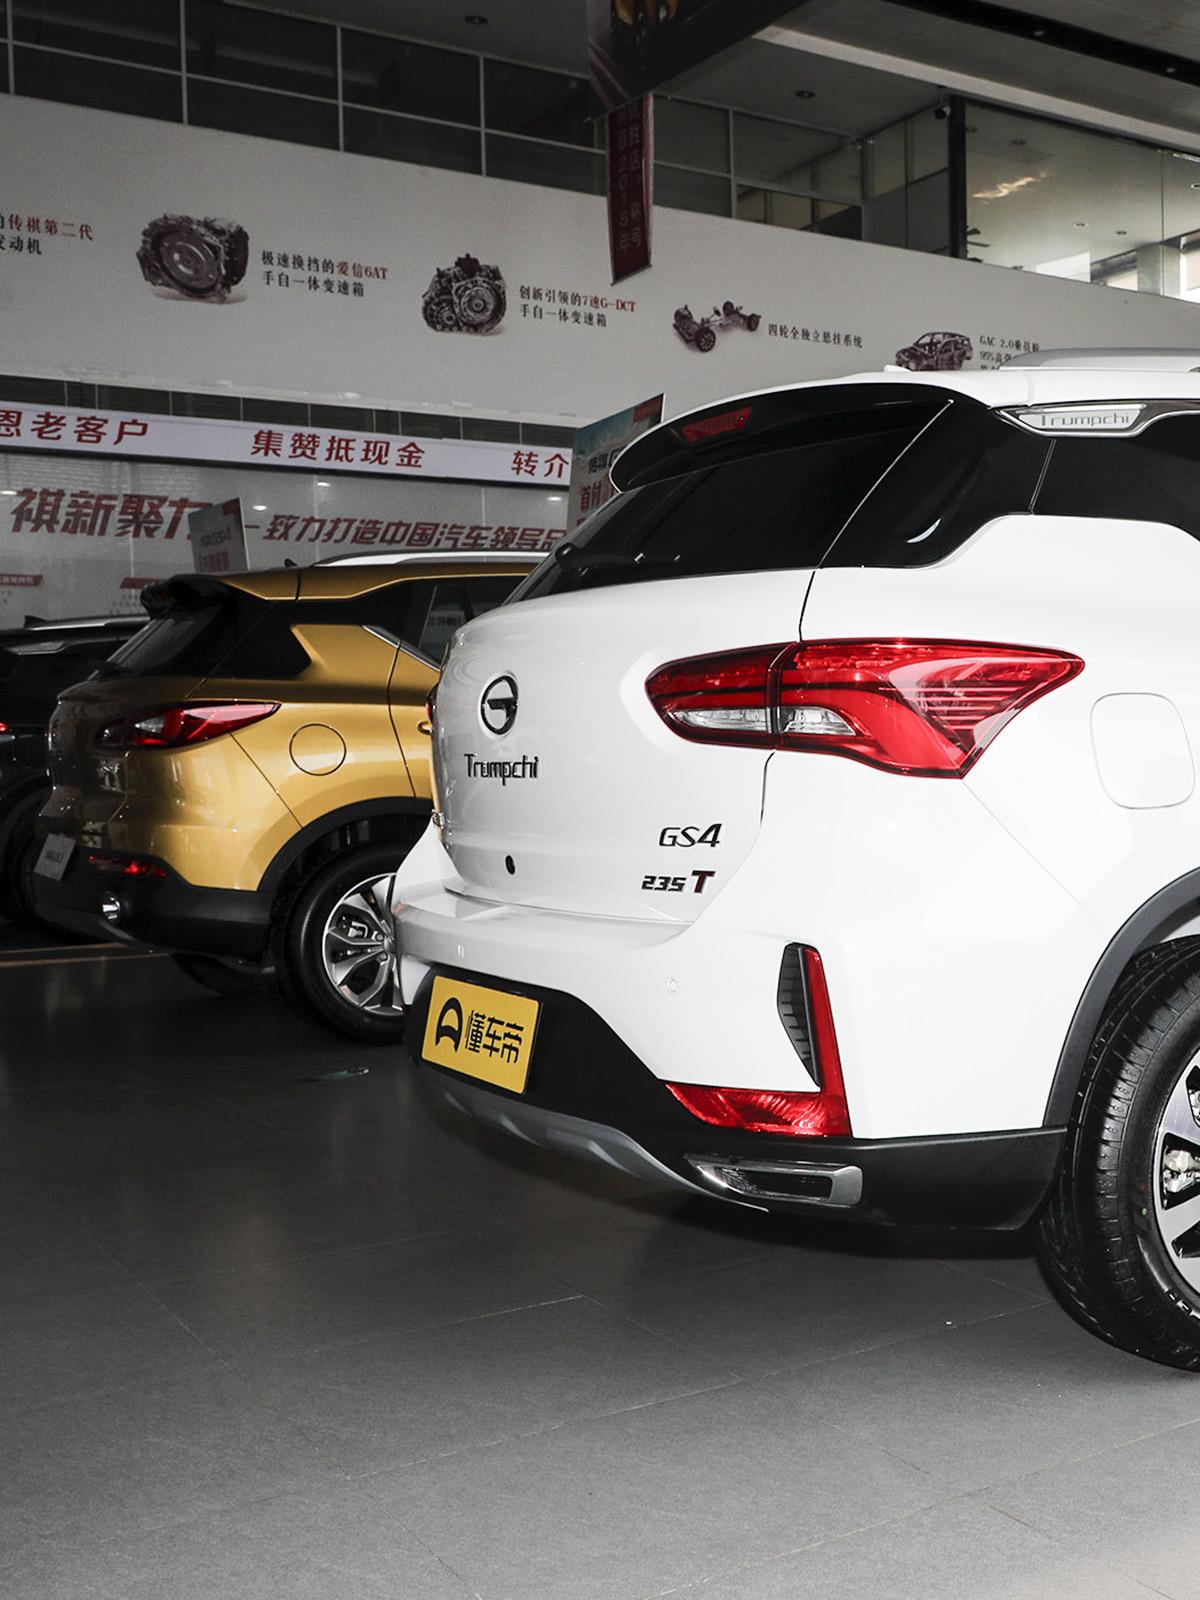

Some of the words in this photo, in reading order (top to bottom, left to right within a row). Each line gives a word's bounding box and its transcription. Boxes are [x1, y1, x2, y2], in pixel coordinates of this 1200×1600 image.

[261, 249, 389, 281] 极速换挡的爱信6AT
[262, 271, 365, 298] 手自一体变速箱
[519, 304, 607, 328] 手自一体变速箱
[768, 323, 863, 349] 四轮全独立悬挂系统
[1041, 413, 1129, 426] Trumpchi
[251, 430, 425, 469] 集赞抵现金
[511, 450, 570, 480] 转介
[11, 488, 214, 540] 祺新聚力
[463, 753, 540, 786] Trumpchi
[658, 823, 722, 848] GS4
[464, 1009, 525, 1064] 懂车帝
